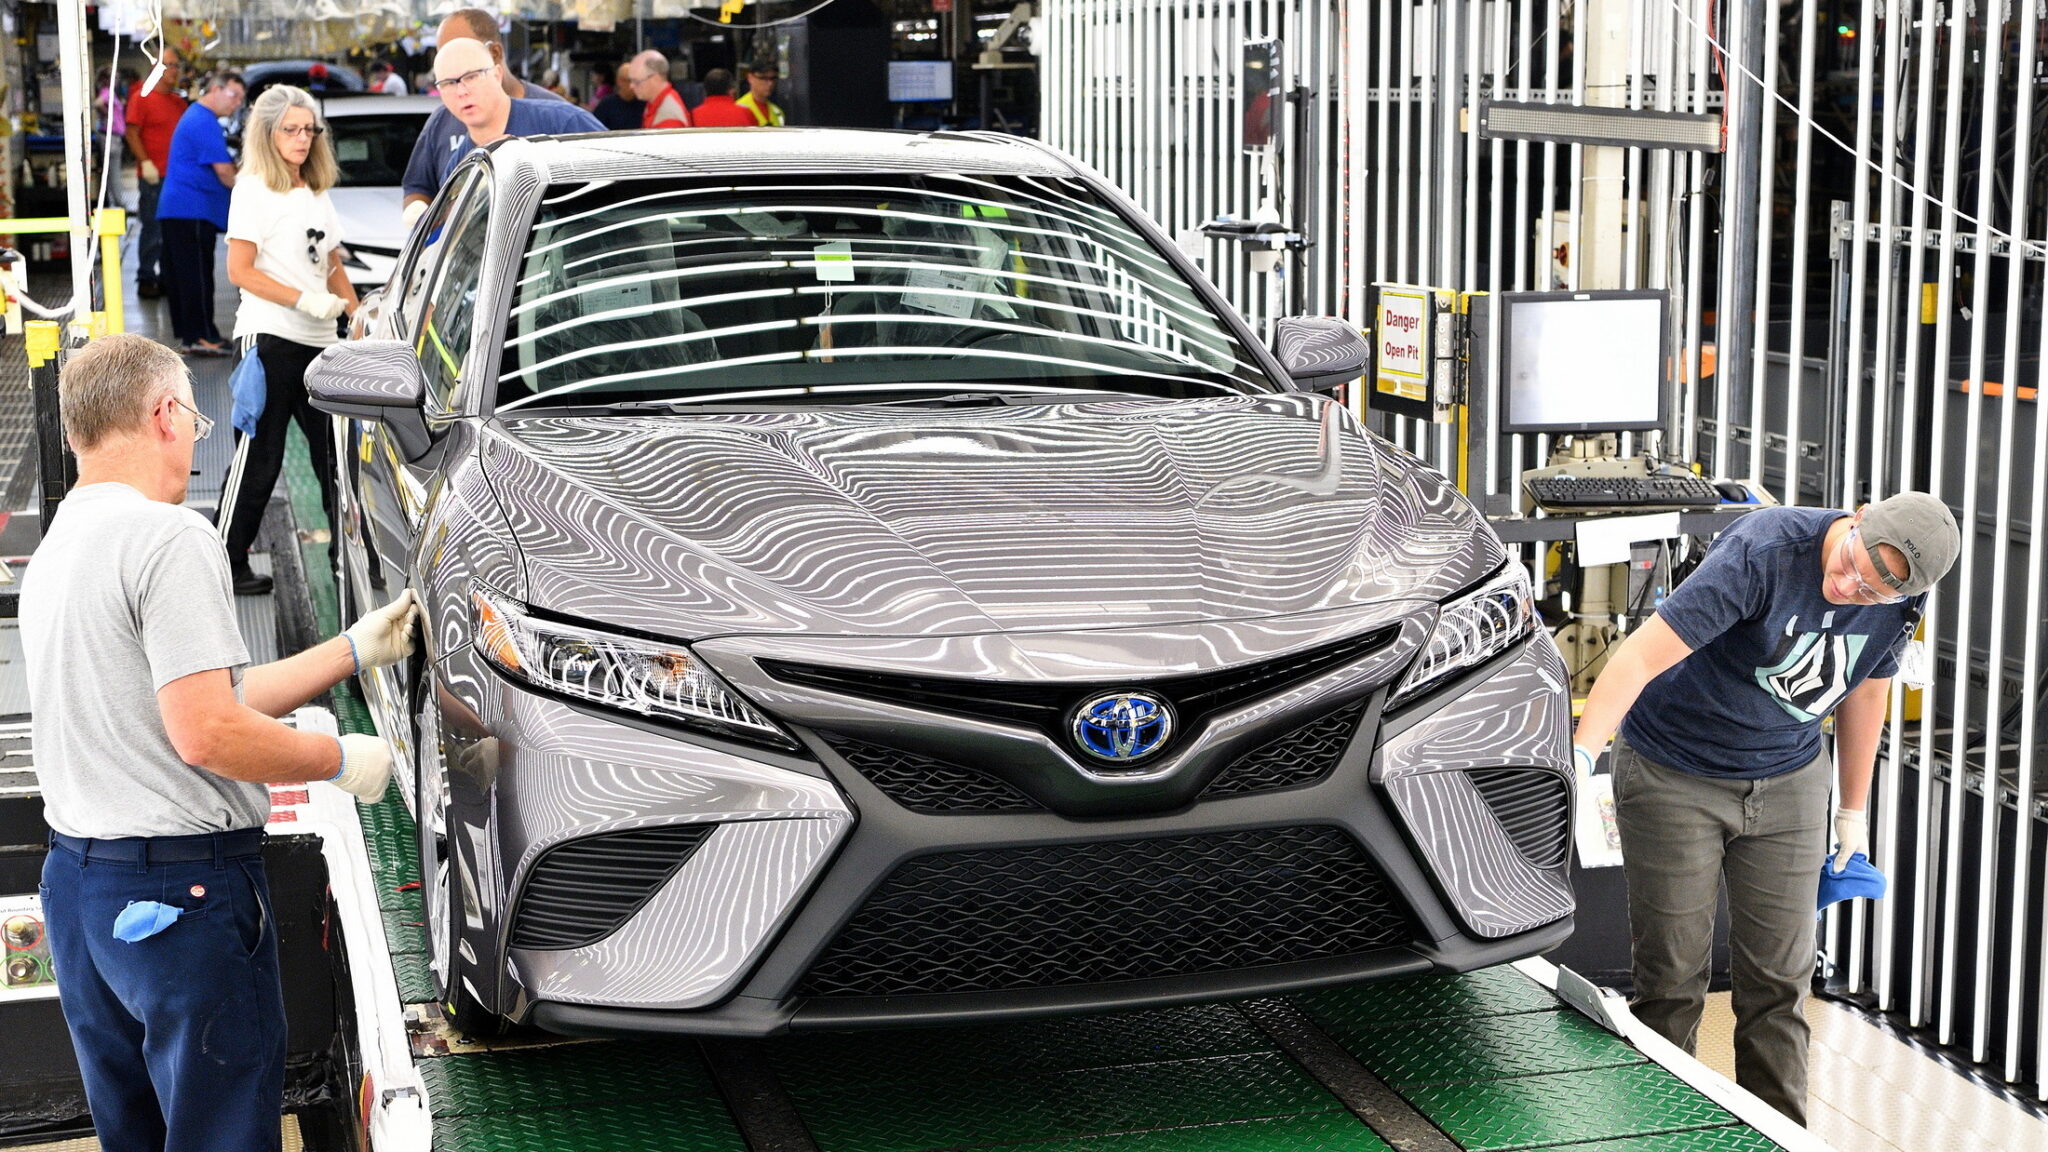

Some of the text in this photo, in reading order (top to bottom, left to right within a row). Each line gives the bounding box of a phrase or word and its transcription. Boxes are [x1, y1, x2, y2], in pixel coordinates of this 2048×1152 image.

[1386, 310, 1420, 332] Danger
[1385, 342, 1419, 360] Open Pit
[1904, 538, 1921, 559] POLO
